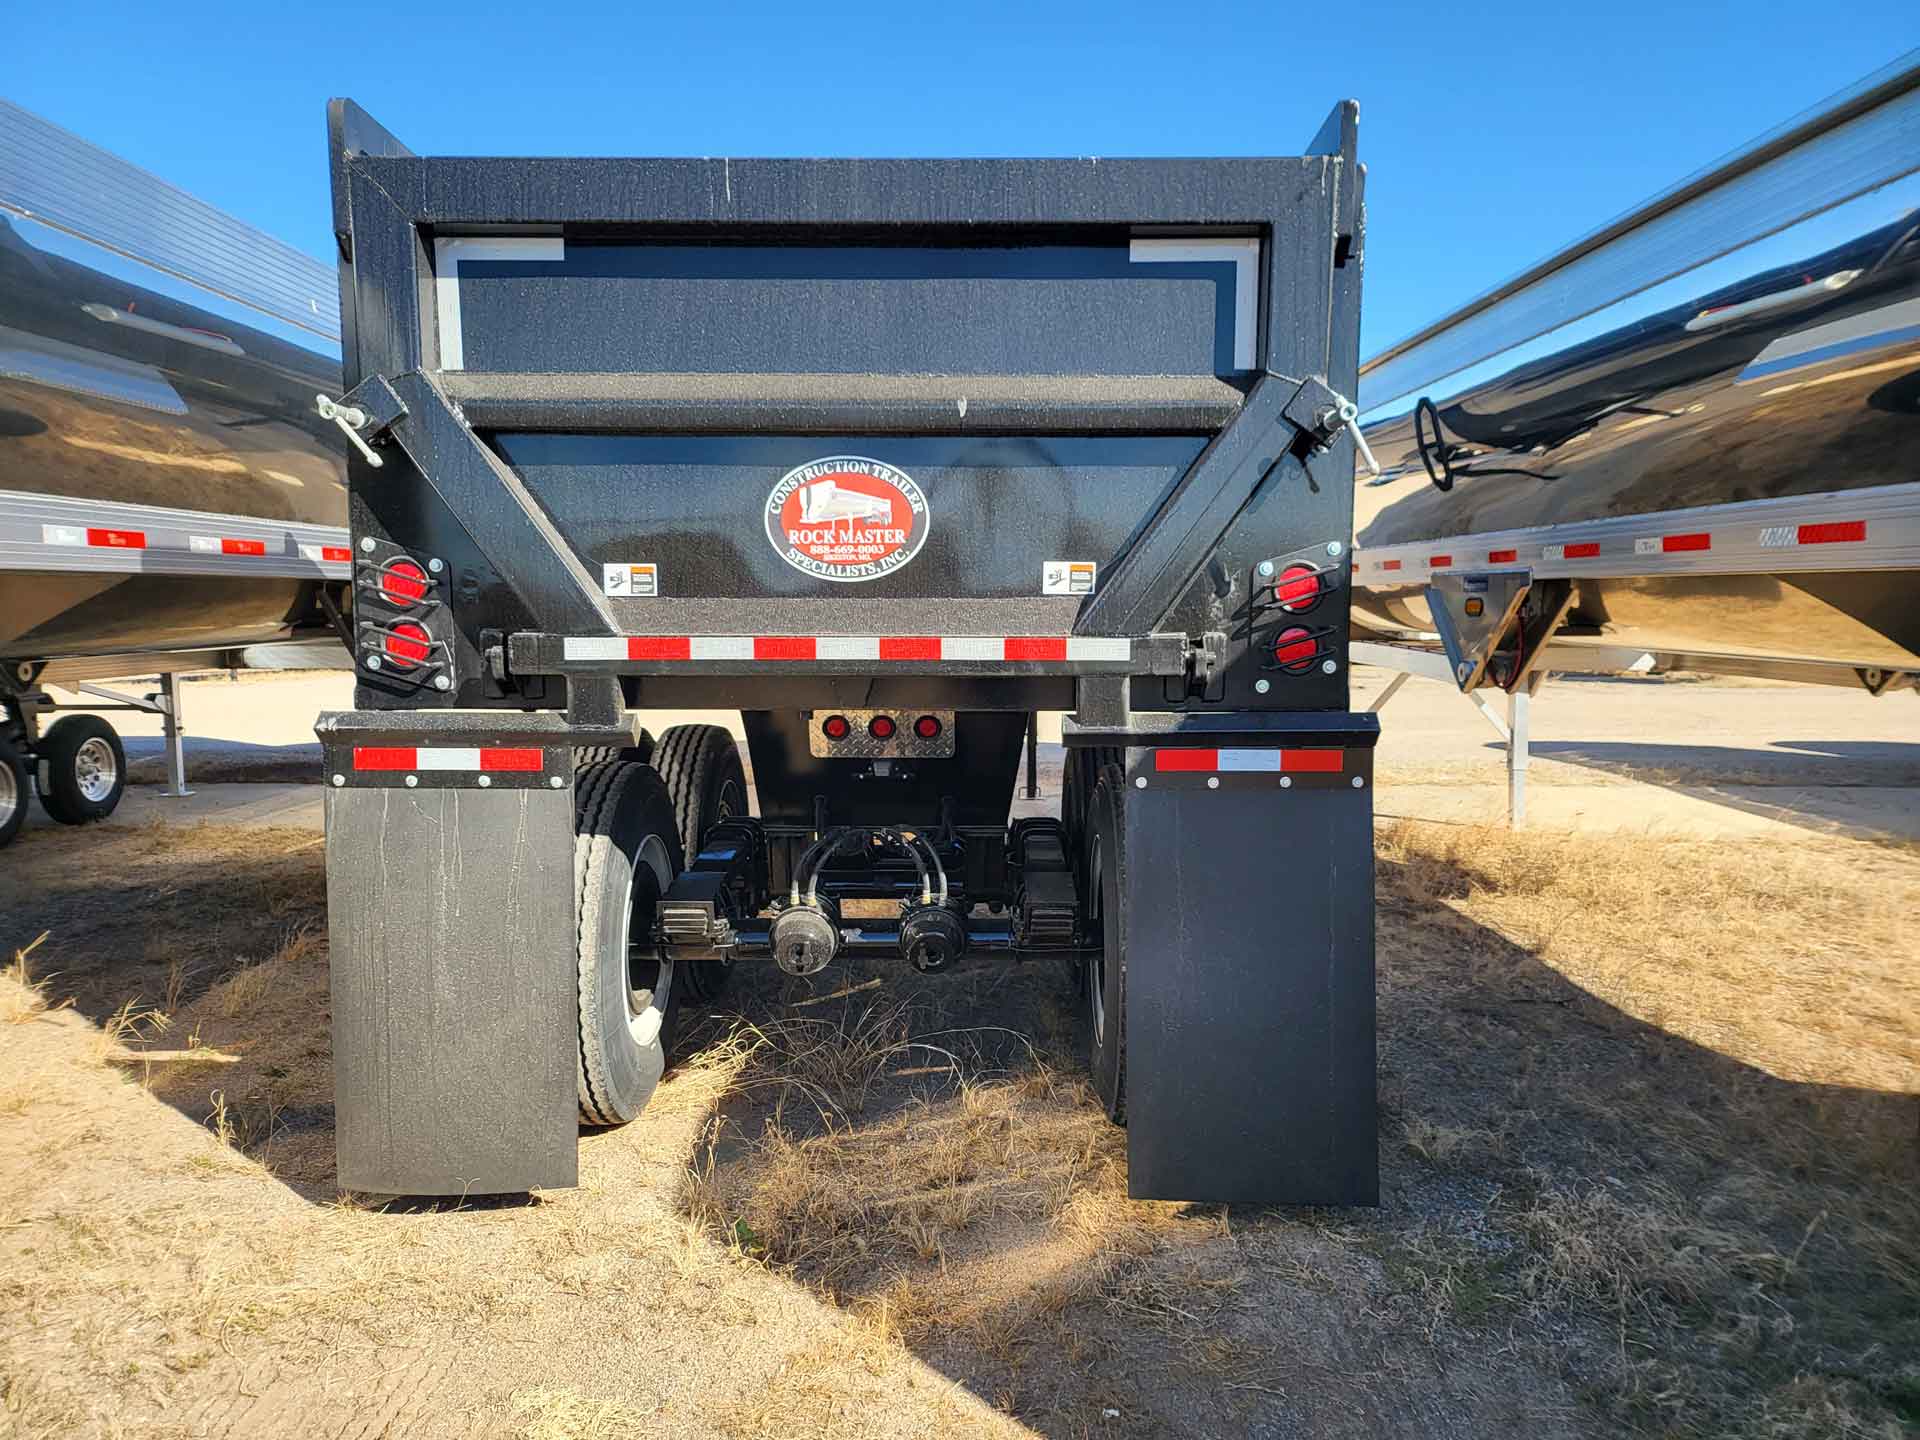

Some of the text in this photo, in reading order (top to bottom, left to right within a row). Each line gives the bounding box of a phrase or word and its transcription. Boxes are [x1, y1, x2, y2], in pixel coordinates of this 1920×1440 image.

[770, 460, 924, 514] CONSTRUCTION TRAILER
[788, 529, 906, 544] ROCK MASTER
[786, 547, 910, 577] SPECIALISTS, INC.
